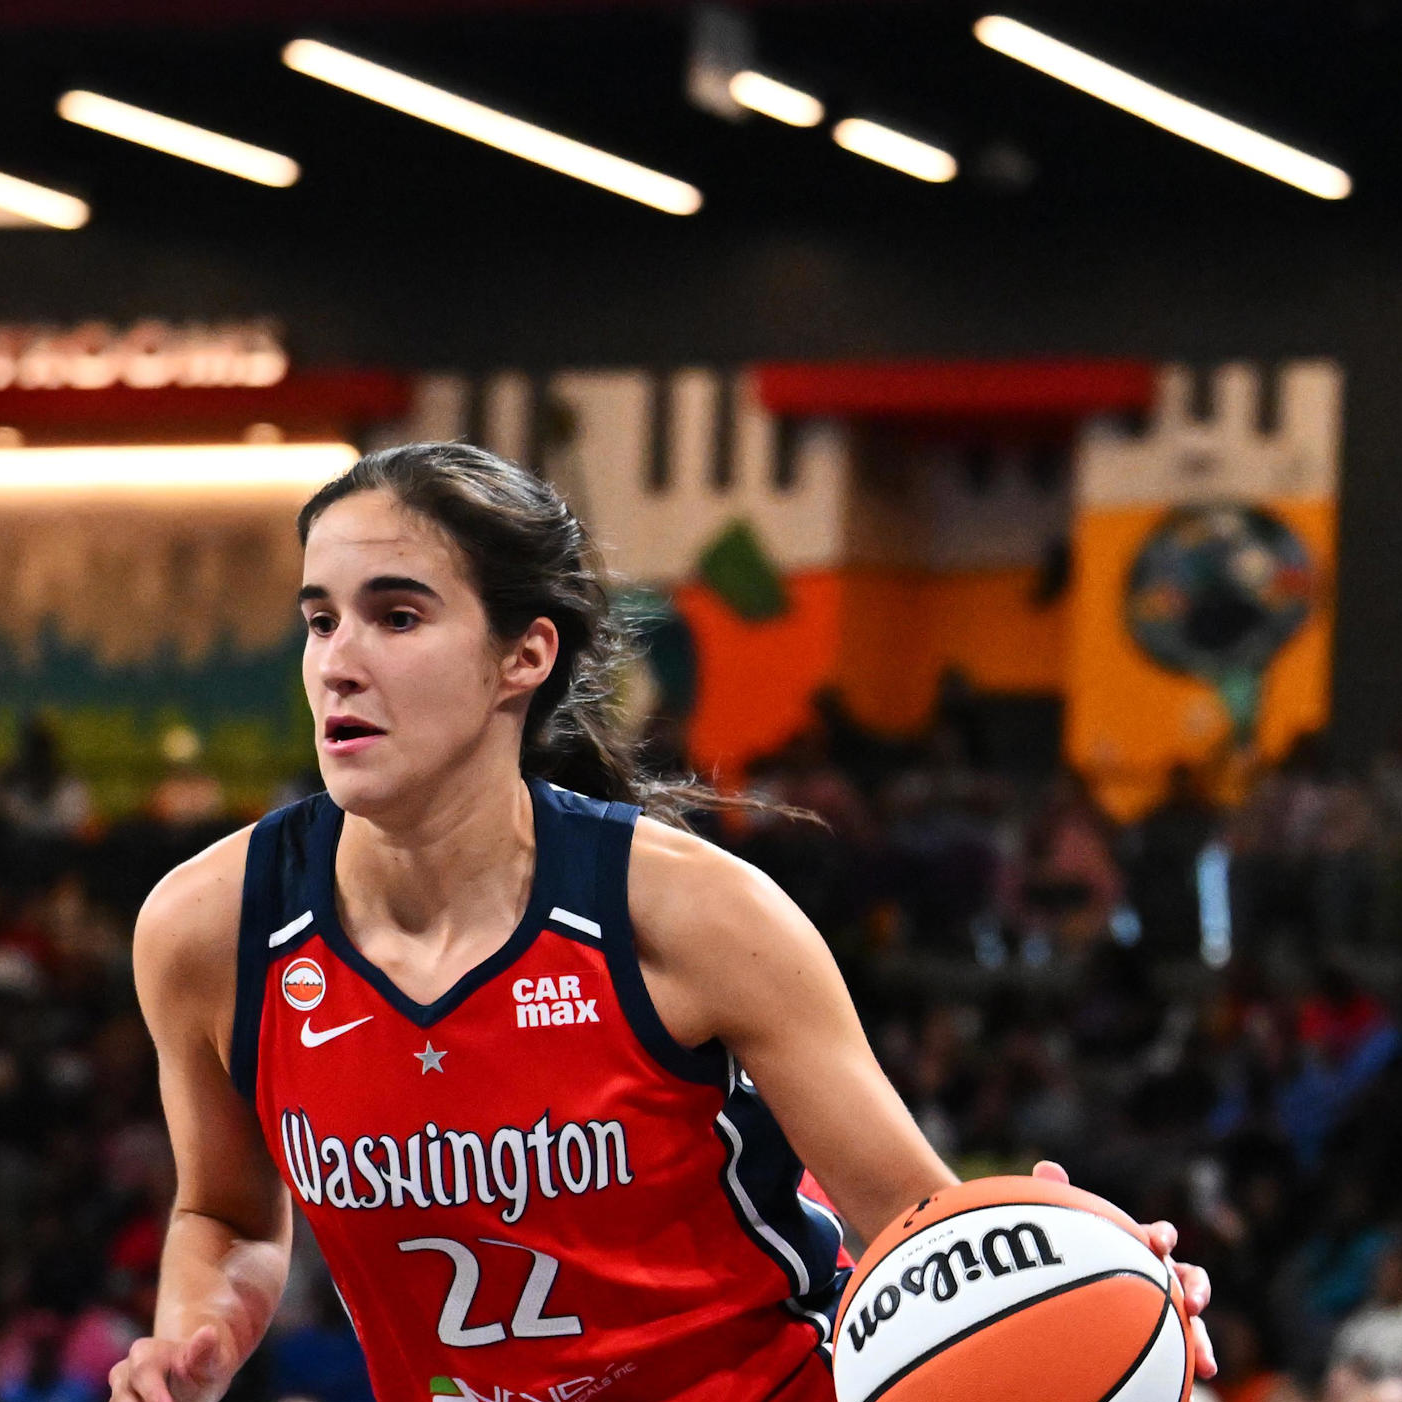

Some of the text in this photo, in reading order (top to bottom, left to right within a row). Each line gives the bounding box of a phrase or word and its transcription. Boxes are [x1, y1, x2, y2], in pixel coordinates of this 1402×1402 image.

[513, 974, 581, 1002] CAR
[516, 998, 600, 1028] max
[282, 1108, 634, 1224] Washington
[399, 1236, 582, 1347] 22
[848, 1222, 1064, 1352] Wilson
